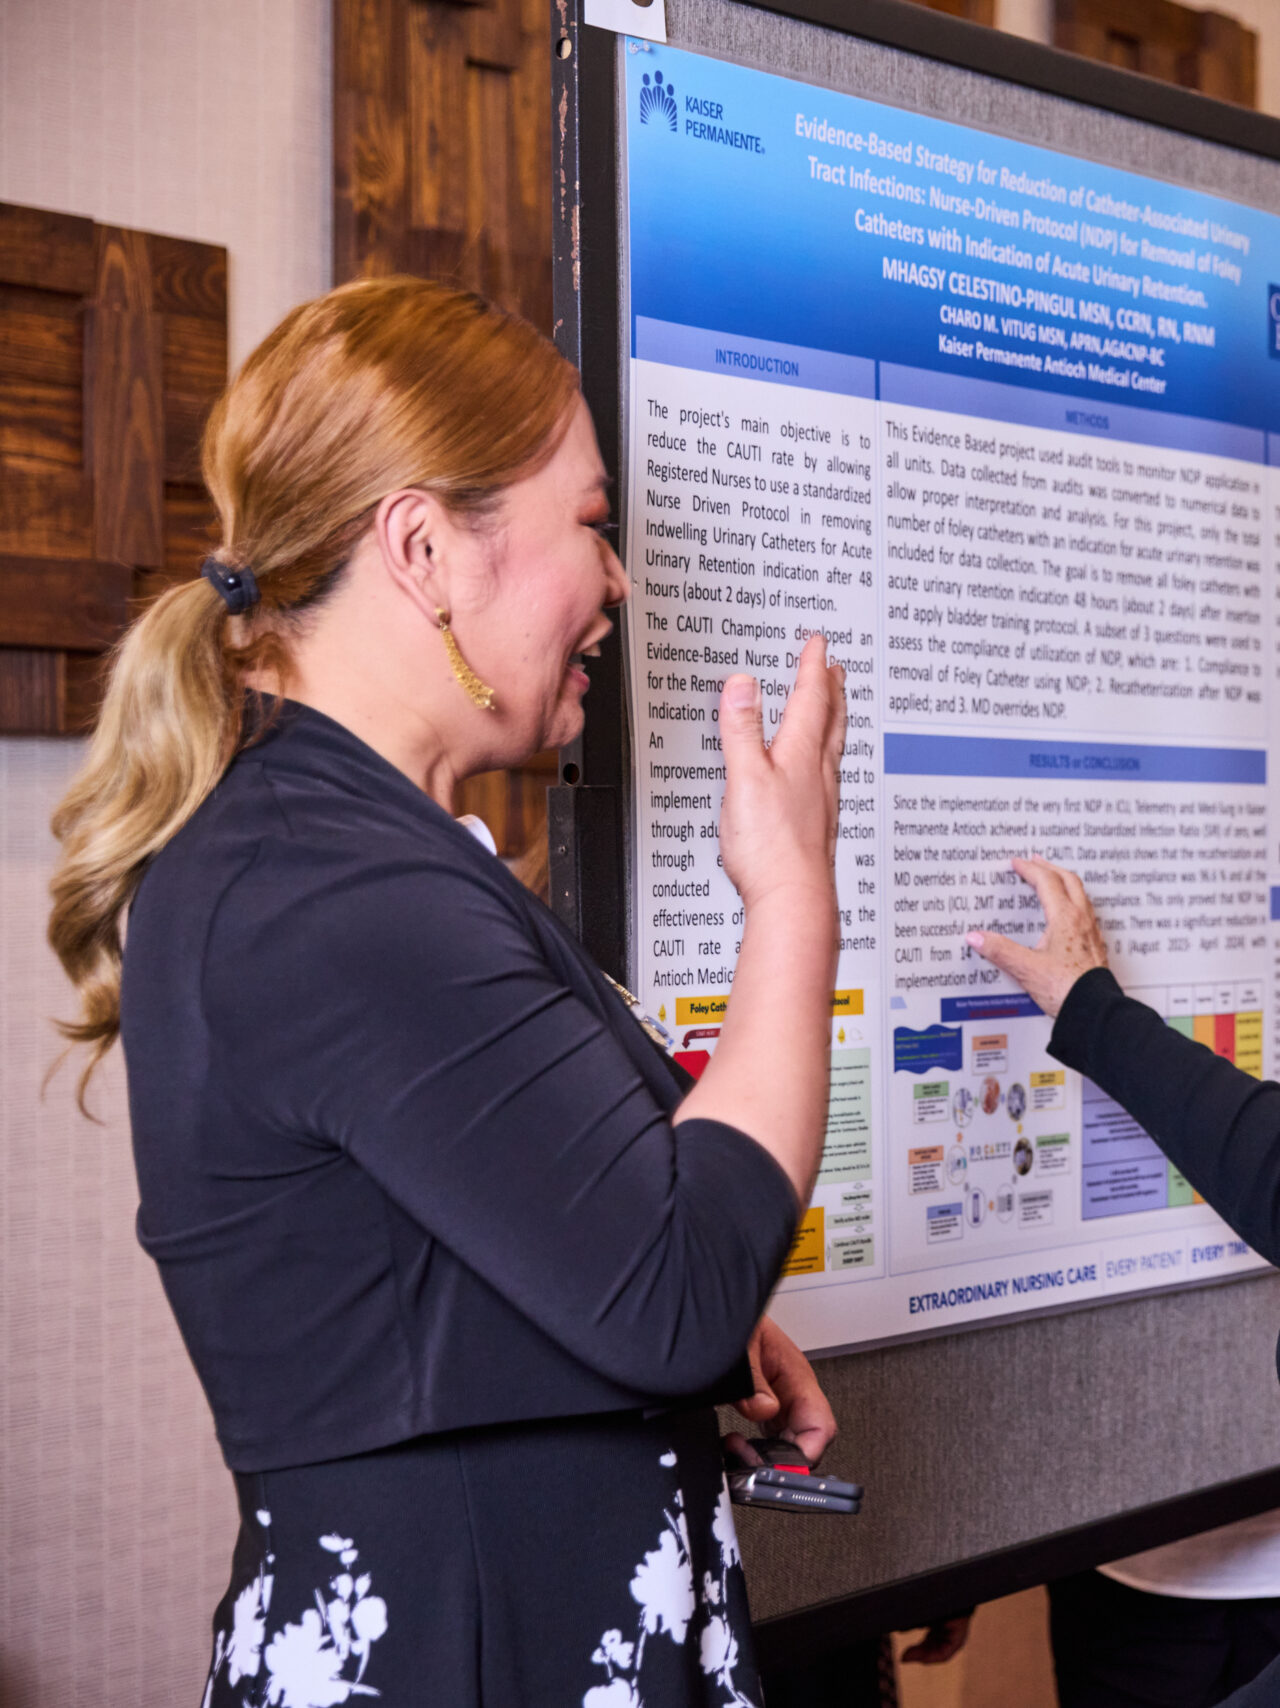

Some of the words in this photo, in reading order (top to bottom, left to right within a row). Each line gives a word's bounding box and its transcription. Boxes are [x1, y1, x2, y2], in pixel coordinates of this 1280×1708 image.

[685, 95, 724, 120] KAISER
[795, 113, 912, 163] Evidence-Based
[915, 144, 974, 184] Strategy
[977, 159, 998, 185] for
[1000, 167, 1067, 203] Reduction
[1069, 186, 1085, 207] of
[1085, 189, 1209, 240] Catheter-Associated
[808, 155, 846, 186] Tract
[849, 165, 925, 204] Infections:
[929, 185, 1019, 227] Nurse-Driven
[1022, 208, 1078, 241] Protocol
[1080, 222, 1118, 255] (NDP)
[1119, 232, 1140, 256] for
[1141, 238, 1196, 269] Removal
[1196, 252, 1212, 272] of
[855, 208, 924, 245] Catheters
[927, 225, 962, 253] with
[966, 234, 1033, 269] Indication
[1035, 251, 1051, 272] of
[1052, 255, 1090, 282] Acute
[1093, 264, 1140, 297] Urinary
[1143, 275, 1207, 307] Retention.
[882, 256, 946, 290] MHAGSY
[949, 271, 1077, 319] CELESTINO-PINGUL
[1079, 299, 1114, 329] MSN,
[1116, 308, 1155, 337] CCRN,
[1157, 316, 1181, 342] RN,
[1183, 321, 1215, 345] RNM
[940, 304, 982, 330] CHARO
[983, 313, 999, 333] M.
[1000, 317, 1036, 341] VITUG
[1038, 325, 1068, 349] MSN,
[716, 349, 799, 376] INTRODUCTION
[938, 334, 974, 357] Kaiser
[976, 341, 1043, 371] Permanente
[1044, 355, 1087, 378] Antioch
[1088, 363, 1130, 387] Medical
[1130, 371, 1167, 393] Center
[647, 399, 668, 419] The
[680, 408, 730, 428] project's
[741, 419, 769, 433] main
[780, 422, 831, 443] objective
[841, 431, 850, 446] is
[859, 435, 871, 449] to
[886, 420, 908, 440] This
[912, 425, 961, 448] Evidence
[965, 433, 996, 454] Based
[999, 443, 1035, 461] project
[648, 431, 686, 451] reduce
[697, 438, 716, 455] the
[727, 441, 761, 461] CAUTI
[772, 451, 794, 466] rate
[804, 452, 817, 472] by
[827, 457, 871, 481] allowing
[886, 452, 899, 468] all
[905, 459, 935, 474] units.
[647, 459, 708, 483] Registered
[712, 468, 751, 489] Nurses
[754, 476, 766, 491] to
[770, 481, 789, 494] use
[793, 483, 799, 495] a
[803, 483, 871, 504] standardized
[647, 489, 681, 509] Nurse
[693, 495, 730, 514] Driven
[742, 501, 789, 521] Protocol
[801, 508, 811, 524] in
[822, 514, 872, 536] removing
[646, 519, 707, 545] Indwelling
[713, 527, 756, 550] Urinary
[761, 532, 816, 553] Catheters
[821, 538, 837, 555] for
[842, 541, 872, 559] Acute
[646, 548, 690, 573] Urinary
[699, 554, 755, 575] Retention
[763, 561, 818, 581] indication
[827, 567, 852, 584] after
[859, 571, 872, 587] 48
[646, 577, 680, 598] hours
[683, 581, 722, 602] (about
[726, 586, 732, 602] 2
[736, 587, 765, 608] days)
[769, 590, 781, 606] of
[784, 592, 836, 610] insertion.
[645, 612, 668, 630] The
[677, 614, 713, 633] CAUTI
[721, 618, 786, 640] Champions
[860, 633, 873, 645] an
[646, 641, 738, 664] Evidence-Based
[745, 649, 779, 667] Nurse
[647, 671, 664, 689] for
[666, 673, 686, 691] the
[691, 674, 725, 693] Remo
[760, 679, 790, 699] Foley
[851, 685, 874, 701] with
[648, 702, 705, 720] Indication
[649, 731, 664, 748] An
[650, 761, 727, 782] Improvement
[863, 770, 874, 783] to
[1029, 753, 1070, 769] RESULTS
[1083, 755, 1140, 771] CONCLUSION
[651, 791, 711, 812] implement
[651, 820, 694, 842] through
[894, 820, 949, 835] Permanente
[952, 822, 986, 836] Antioch
[990, 824, 1028, 836] achieved
[652, 850, 694, 871] through
[855, 854, 875, 866] was
[652, 880, 709, 897] conducted
[858, 879, 875, 894] the
[653, 909, 724, 927] effectiveness
[732, 907, 745, 925] of
[858, 906, 876, 921] the
[653, 939, 684, 957] CAUTI
[698, 940, 721, 955] rate
[653, 968, 693, 986] Antioch
[698, 967, 735, 984] Medic
[690, 1003, 709, 1015] Foley
[909, 1280, 1009, 1314] EXTRAORDINARY
[1012, 1270, 1064, 1295] NURSING
[1067, 1265, 1096, 1284] CARE
[1106, 1257, 1137, 1278] EVERY
[1140, 1250, 1183, 1273] PATIENT
[1191, 1245, 1224, 1264] EVERY
